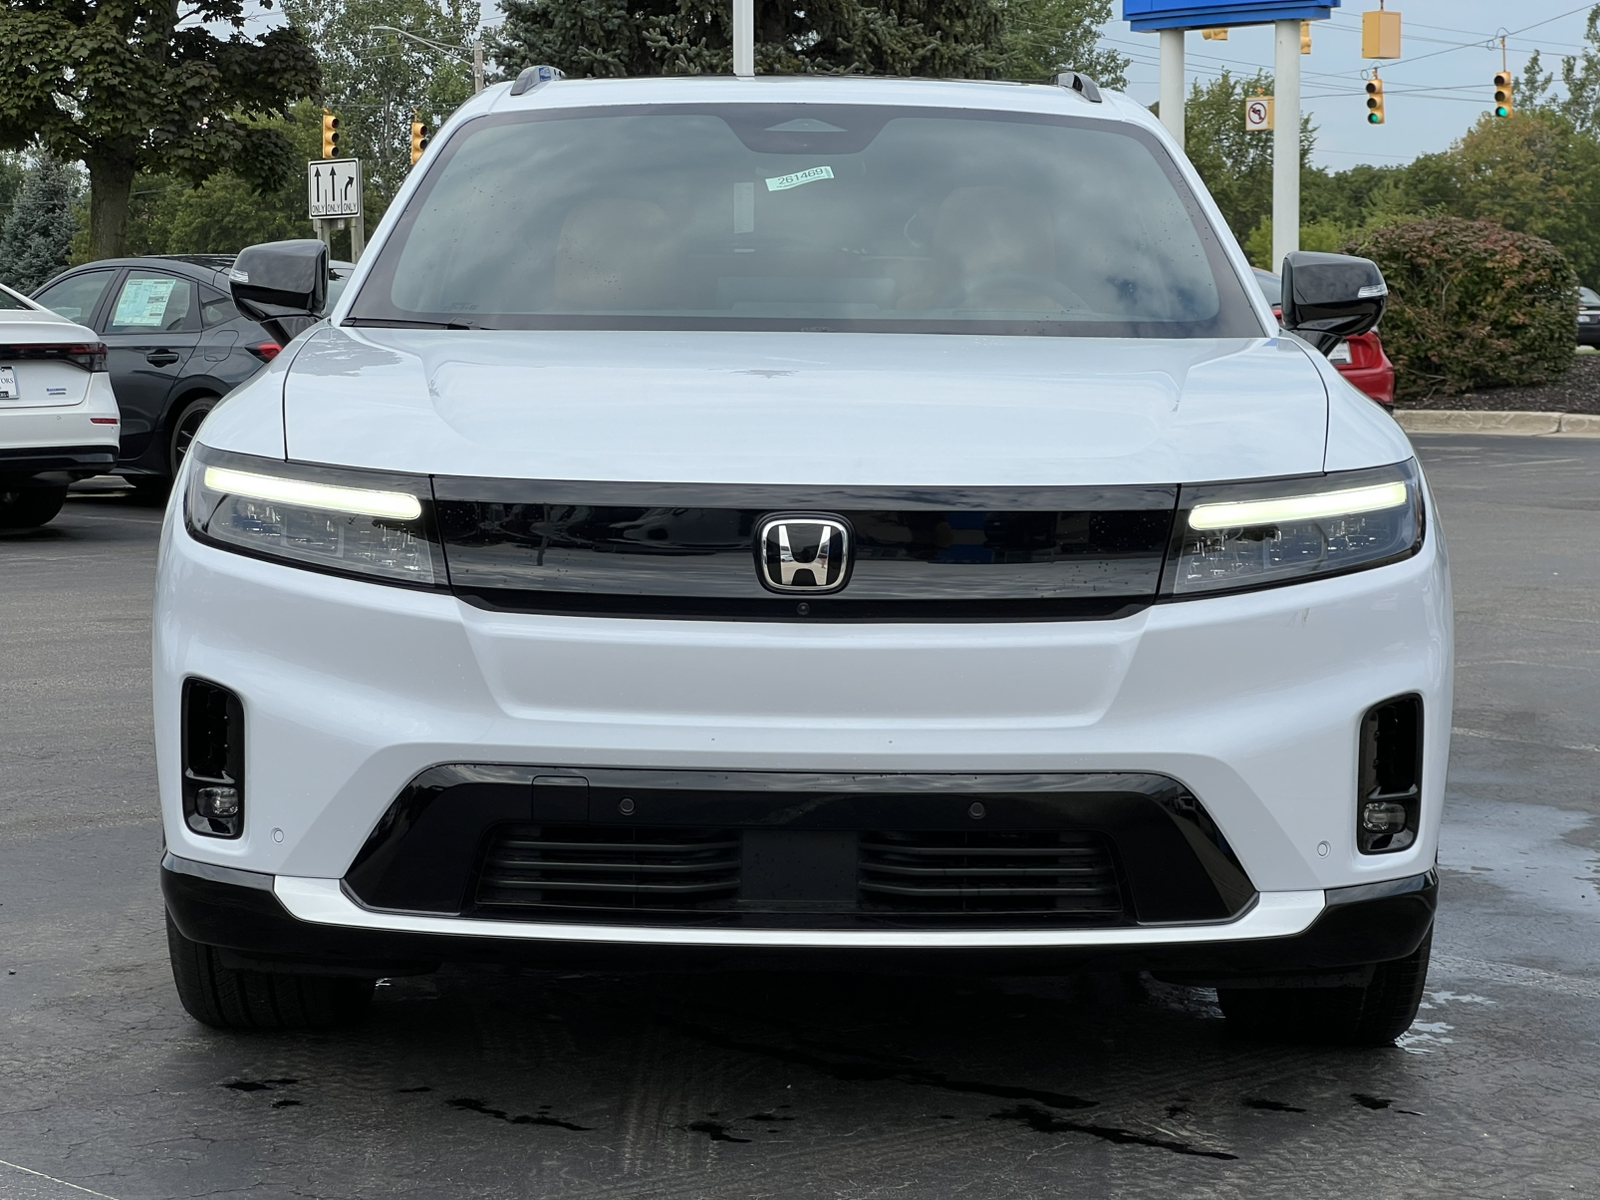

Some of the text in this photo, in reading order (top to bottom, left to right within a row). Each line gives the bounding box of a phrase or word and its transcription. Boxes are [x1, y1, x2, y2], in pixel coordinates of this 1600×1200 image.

[777, 167, 824, 185] 261469
[312, 204, 326, 213] ONLY
[327, 203, 341, 212] ONLY
[343, 203, 357, 211] ONLY
